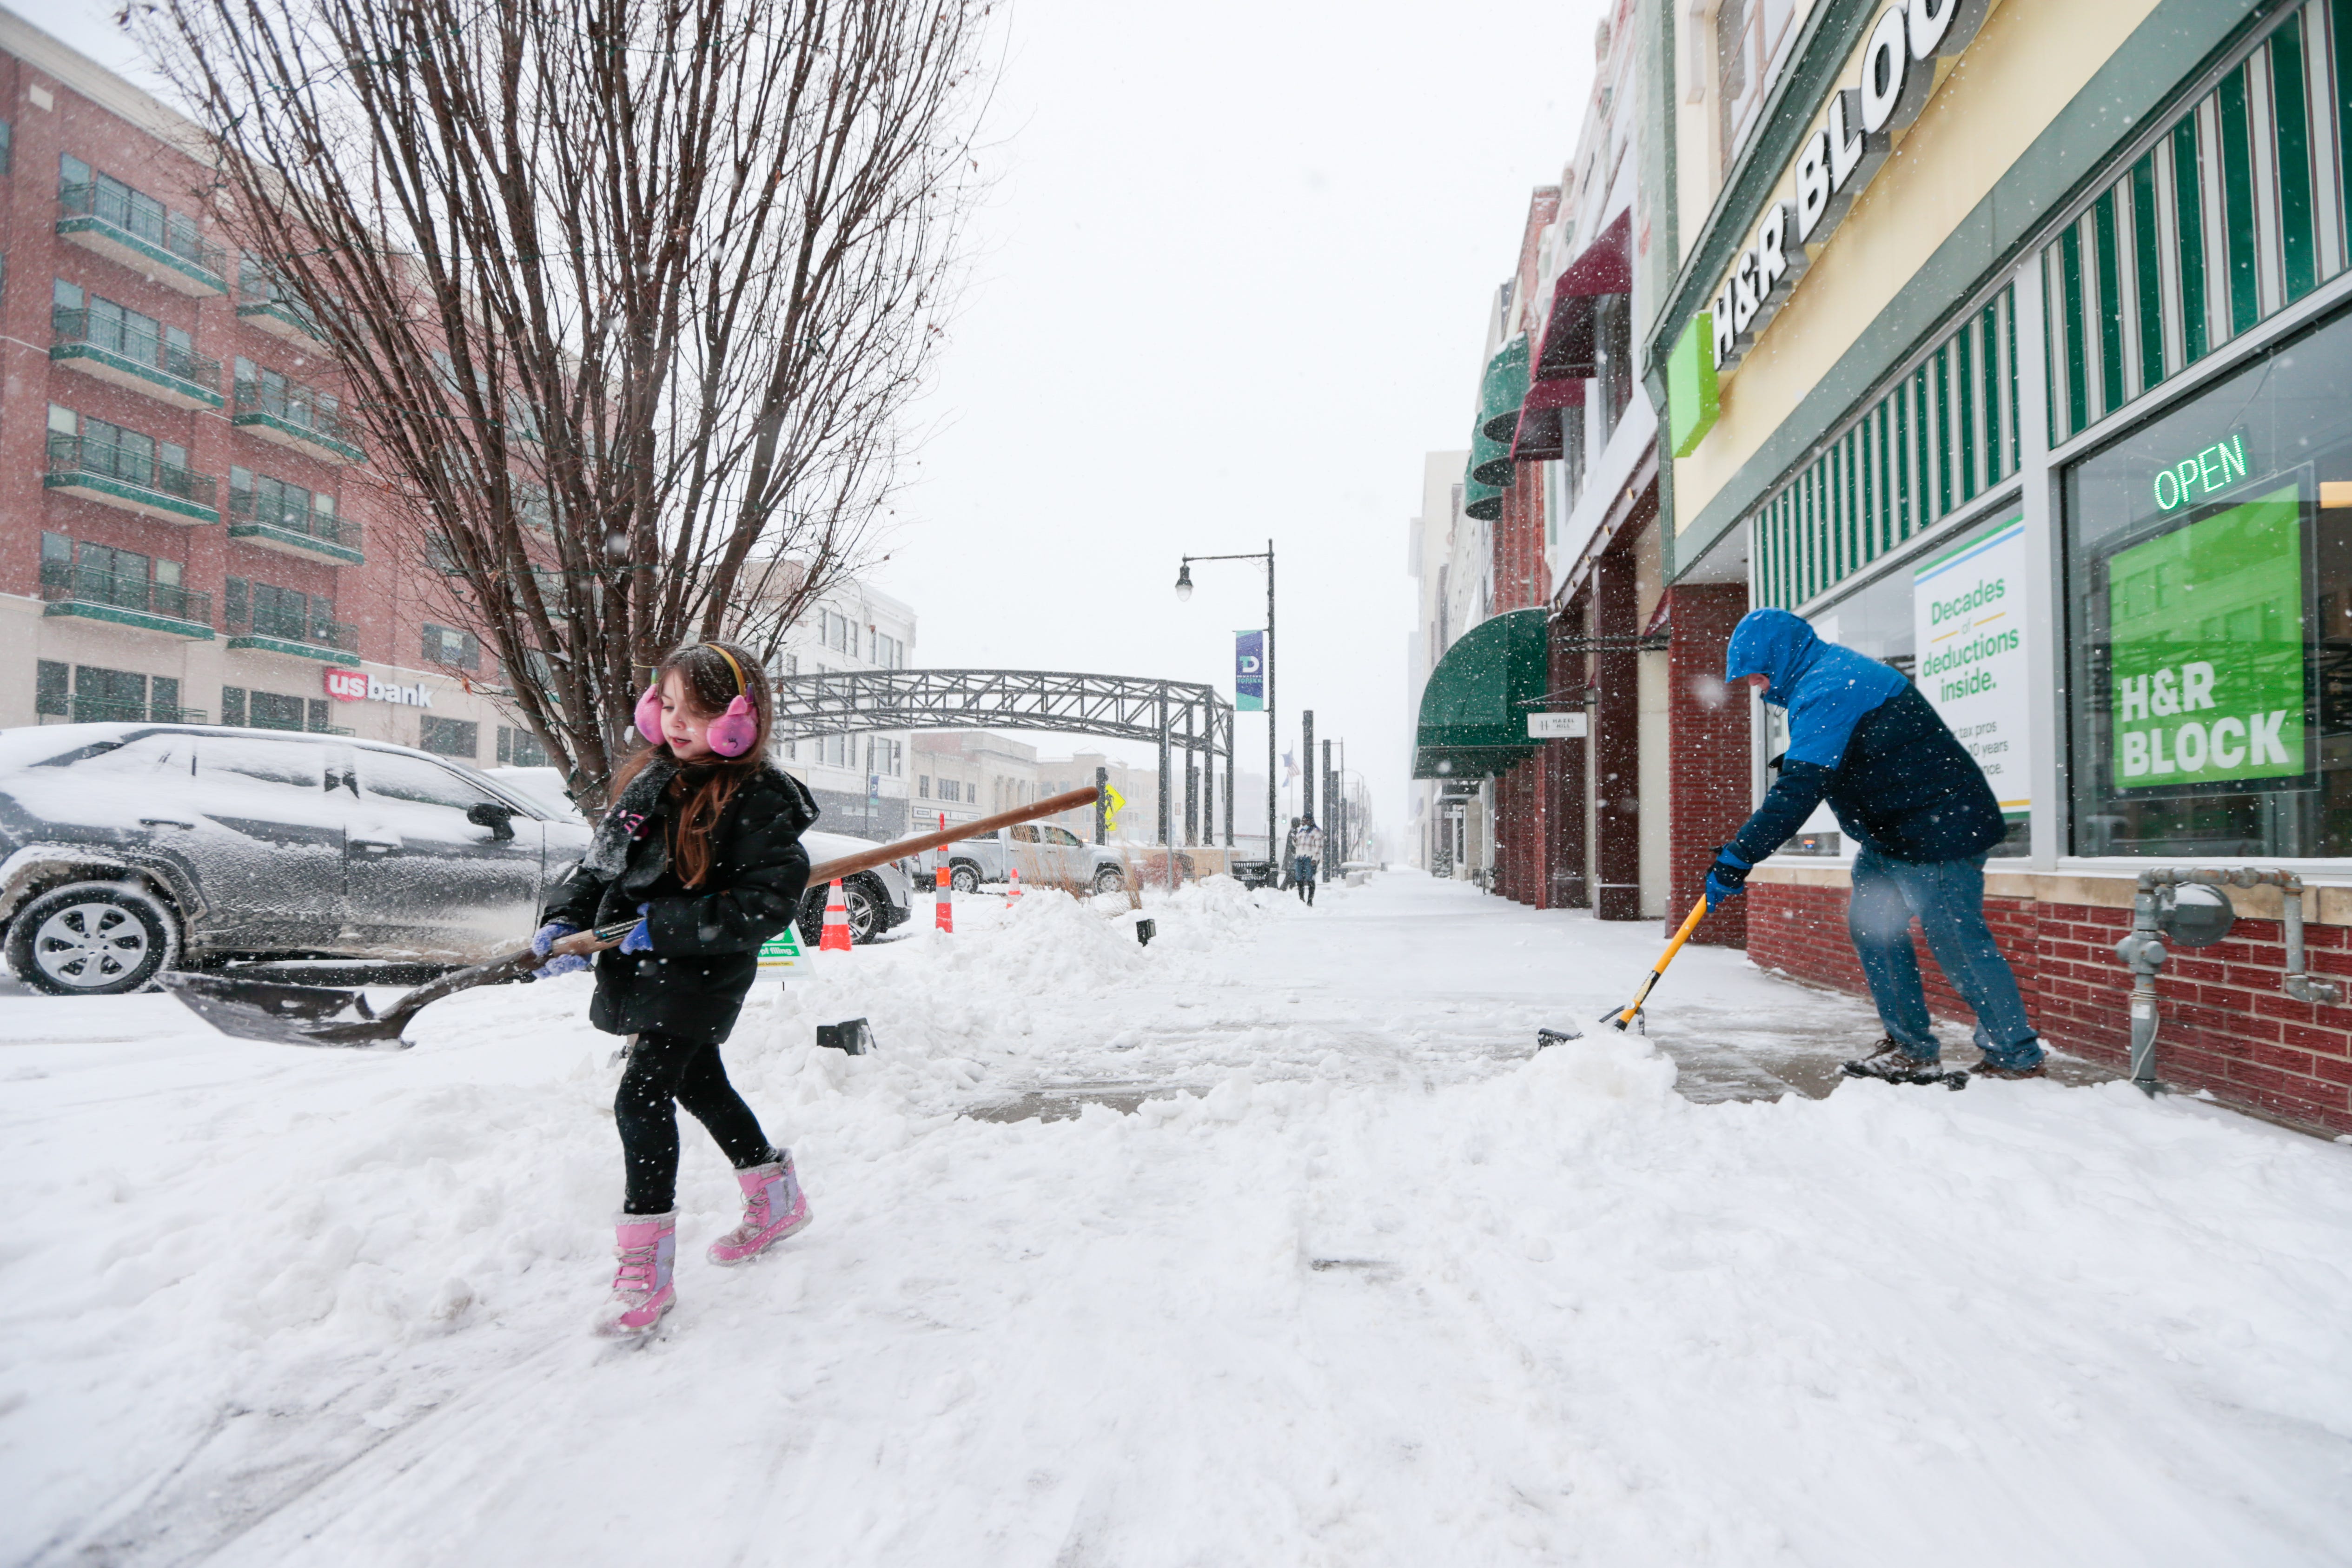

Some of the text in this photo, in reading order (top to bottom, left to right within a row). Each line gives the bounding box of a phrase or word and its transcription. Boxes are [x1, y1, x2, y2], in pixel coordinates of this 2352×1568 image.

[1712, 202, 1788, 371] H&R
[2153, 435, 2247, 510] OPEN
[1931, 577, 2005, 626] Decades
[1961, 617, 1972, 635] of
[1922, 628, 2020, 678] deductions
[1941, 669, 1997, 703] inside.
[2120, 661, 2216, 722] H&R
[1959, 727, 1973, 738] tax
[1976, 721, 1998, 738] pros
[1968, 740, 2009, 758] 10 years
[2122, 709, 2289, 777] BLOCK
